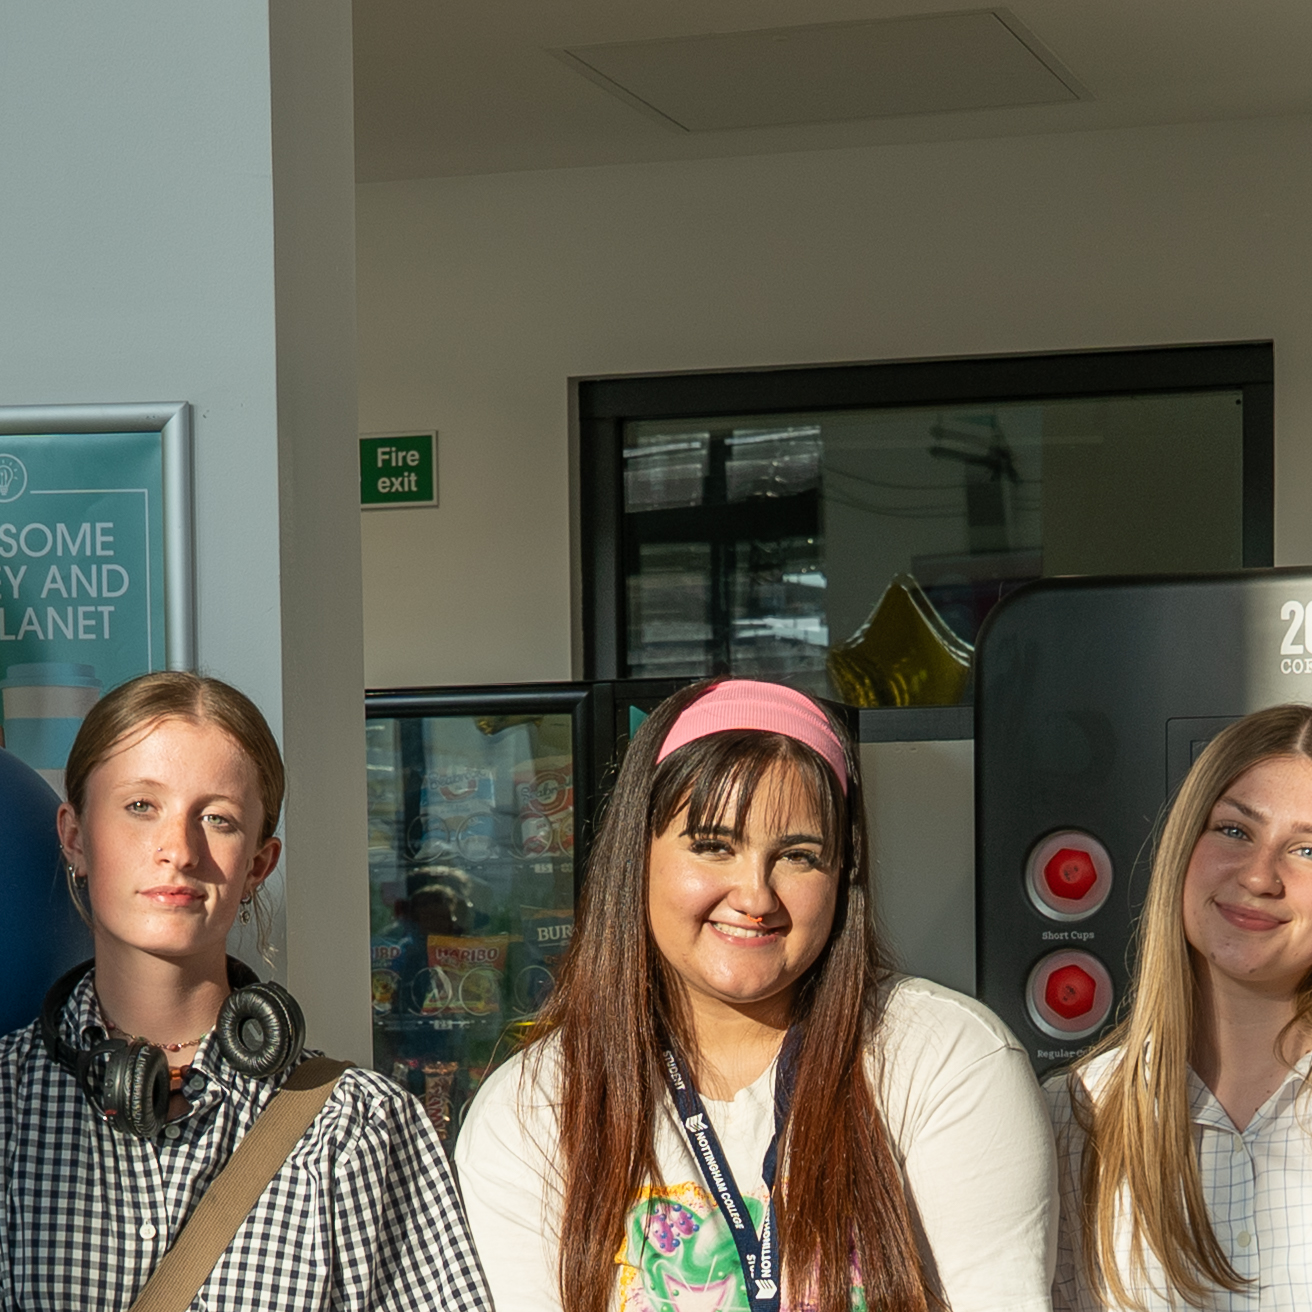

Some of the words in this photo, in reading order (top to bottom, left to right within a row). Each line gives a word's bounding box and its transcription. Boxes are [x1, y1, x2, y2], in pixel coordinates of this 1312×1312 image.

[376, 446, 419, 468] Fire
[377, 471, 419, 494] exit
[40, 564, 130, 599] AND
[1041, 930, 1069, 940] Short
[1070, 930, 1095, 941] Cups
[435, 946, 499, 962] HARIBO
[1037, 1048, 1075, 1060] Regular
[662, 1049, 686, 1091] STUDENT
[694, 1131, 729, 1197] NOTTINGHAM
[720, 1193, 746, 1230] COLLEGE
